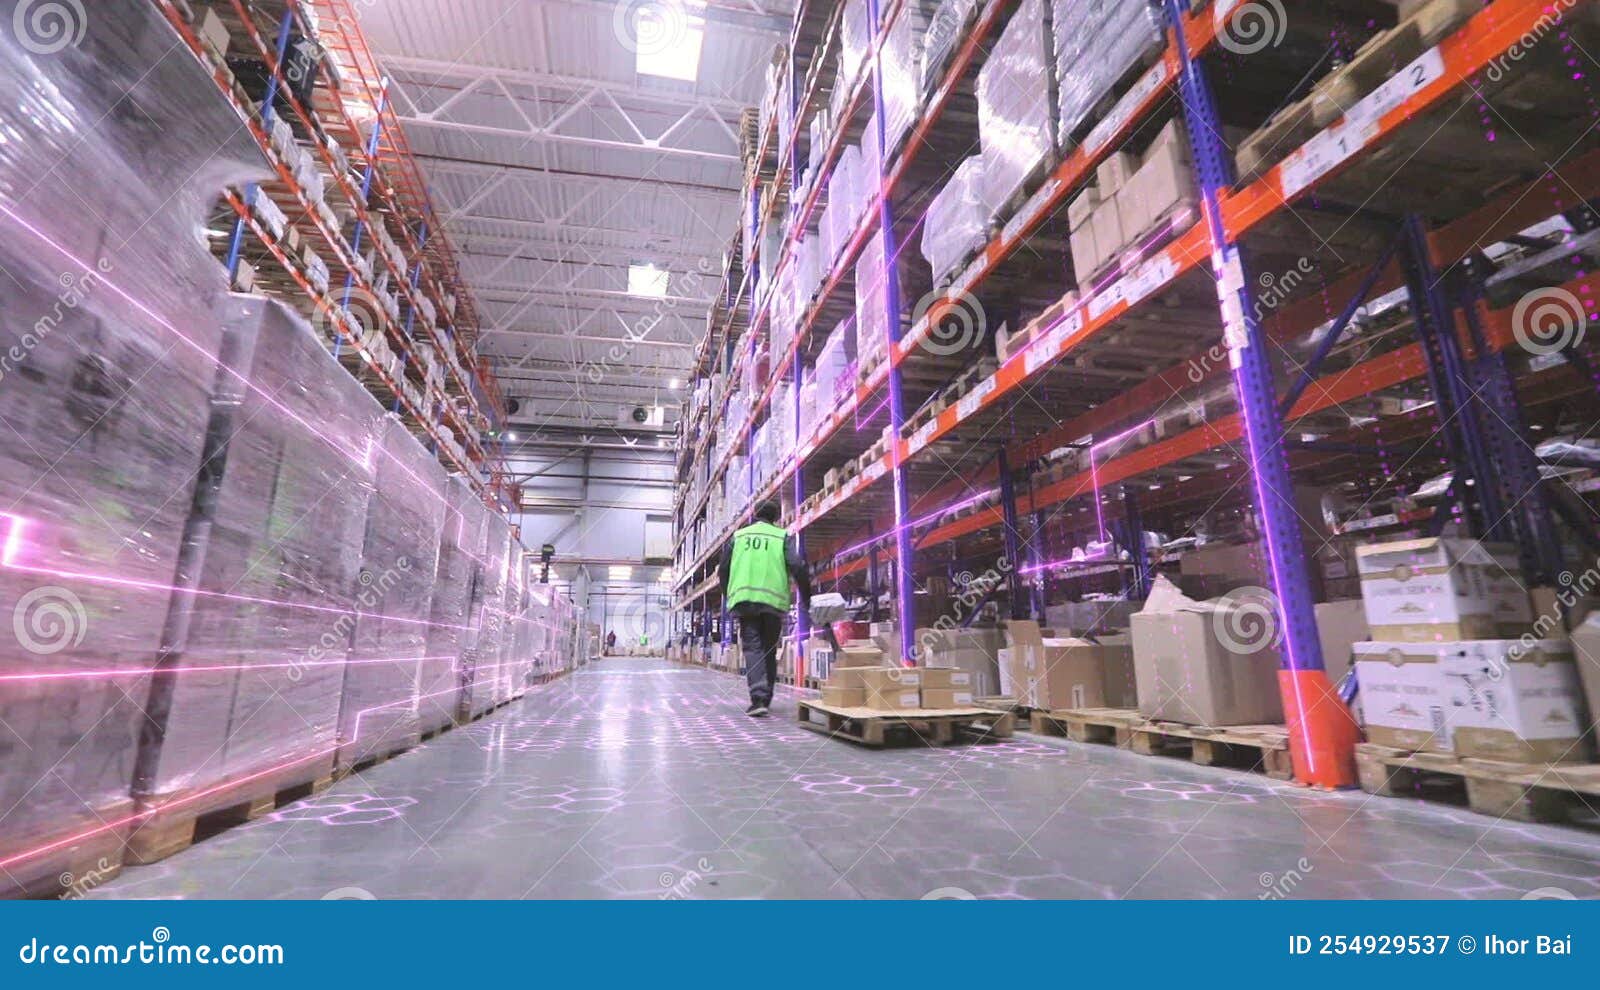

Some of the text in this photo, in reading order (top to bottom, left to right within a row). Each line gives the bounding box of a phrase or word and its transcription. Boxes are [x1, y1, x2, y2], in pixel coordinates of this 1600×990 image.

[1410, 65, 1426, 87] 2
[1337, 137, 1348, 154] 1
[744, 536, 769, 552] 301
